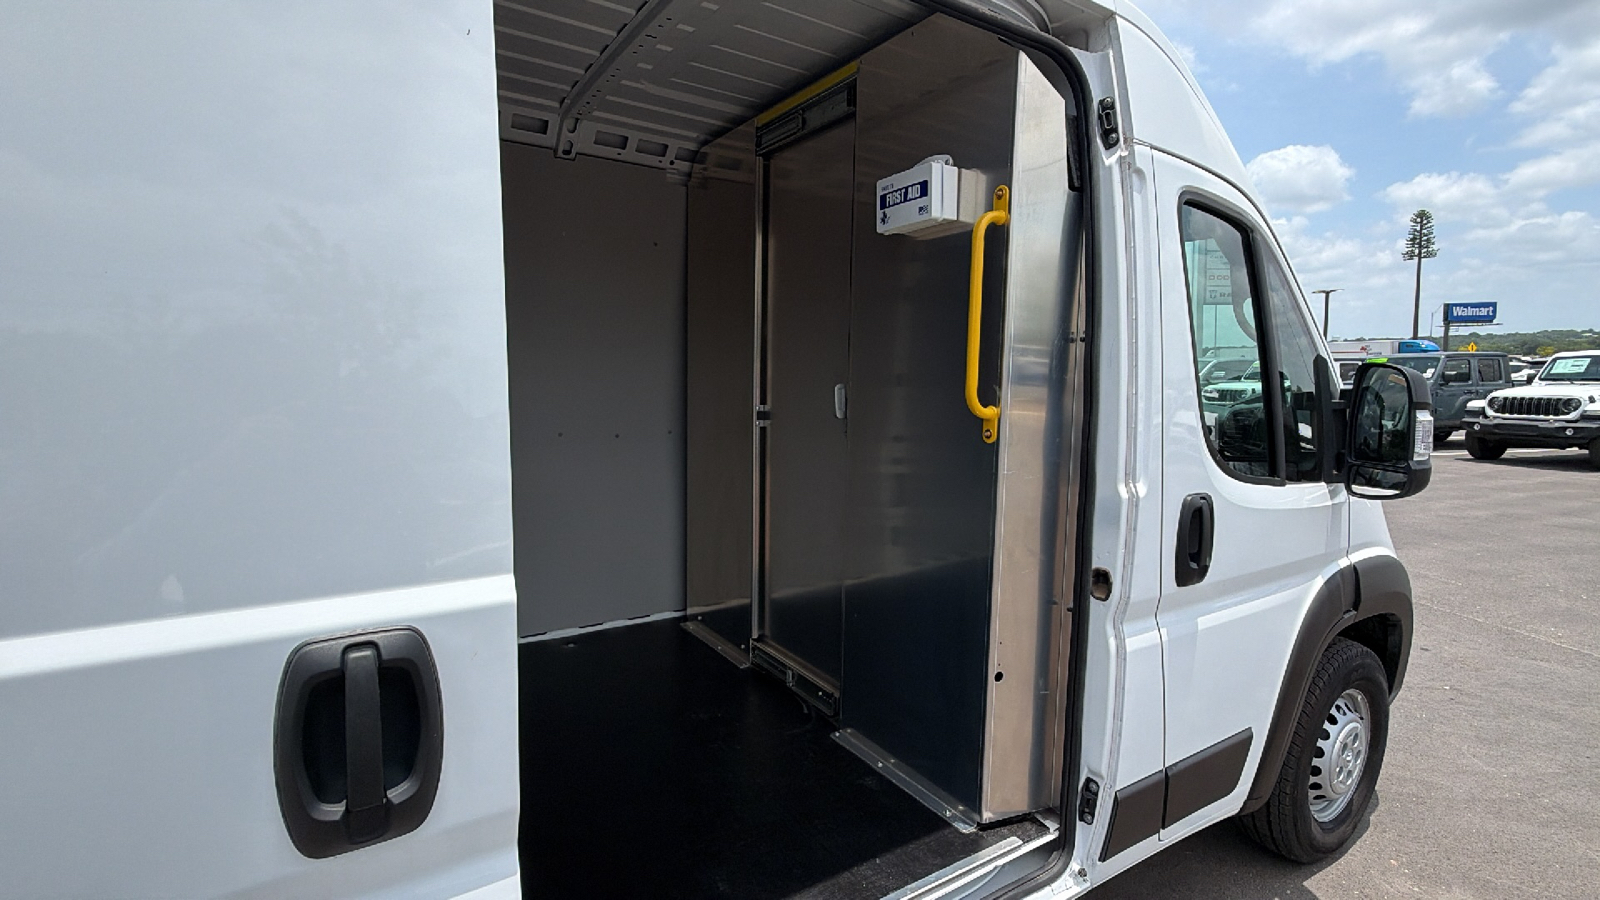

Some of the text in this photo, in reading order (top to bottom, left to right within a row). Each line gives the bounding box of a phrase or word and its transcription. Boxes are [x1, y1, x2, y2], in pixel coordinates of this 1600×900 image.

[886, 189, 906, 207] FIRST
[907, 184, 921, 199] AID
[1453, 306, 1494, 316] Walmart
